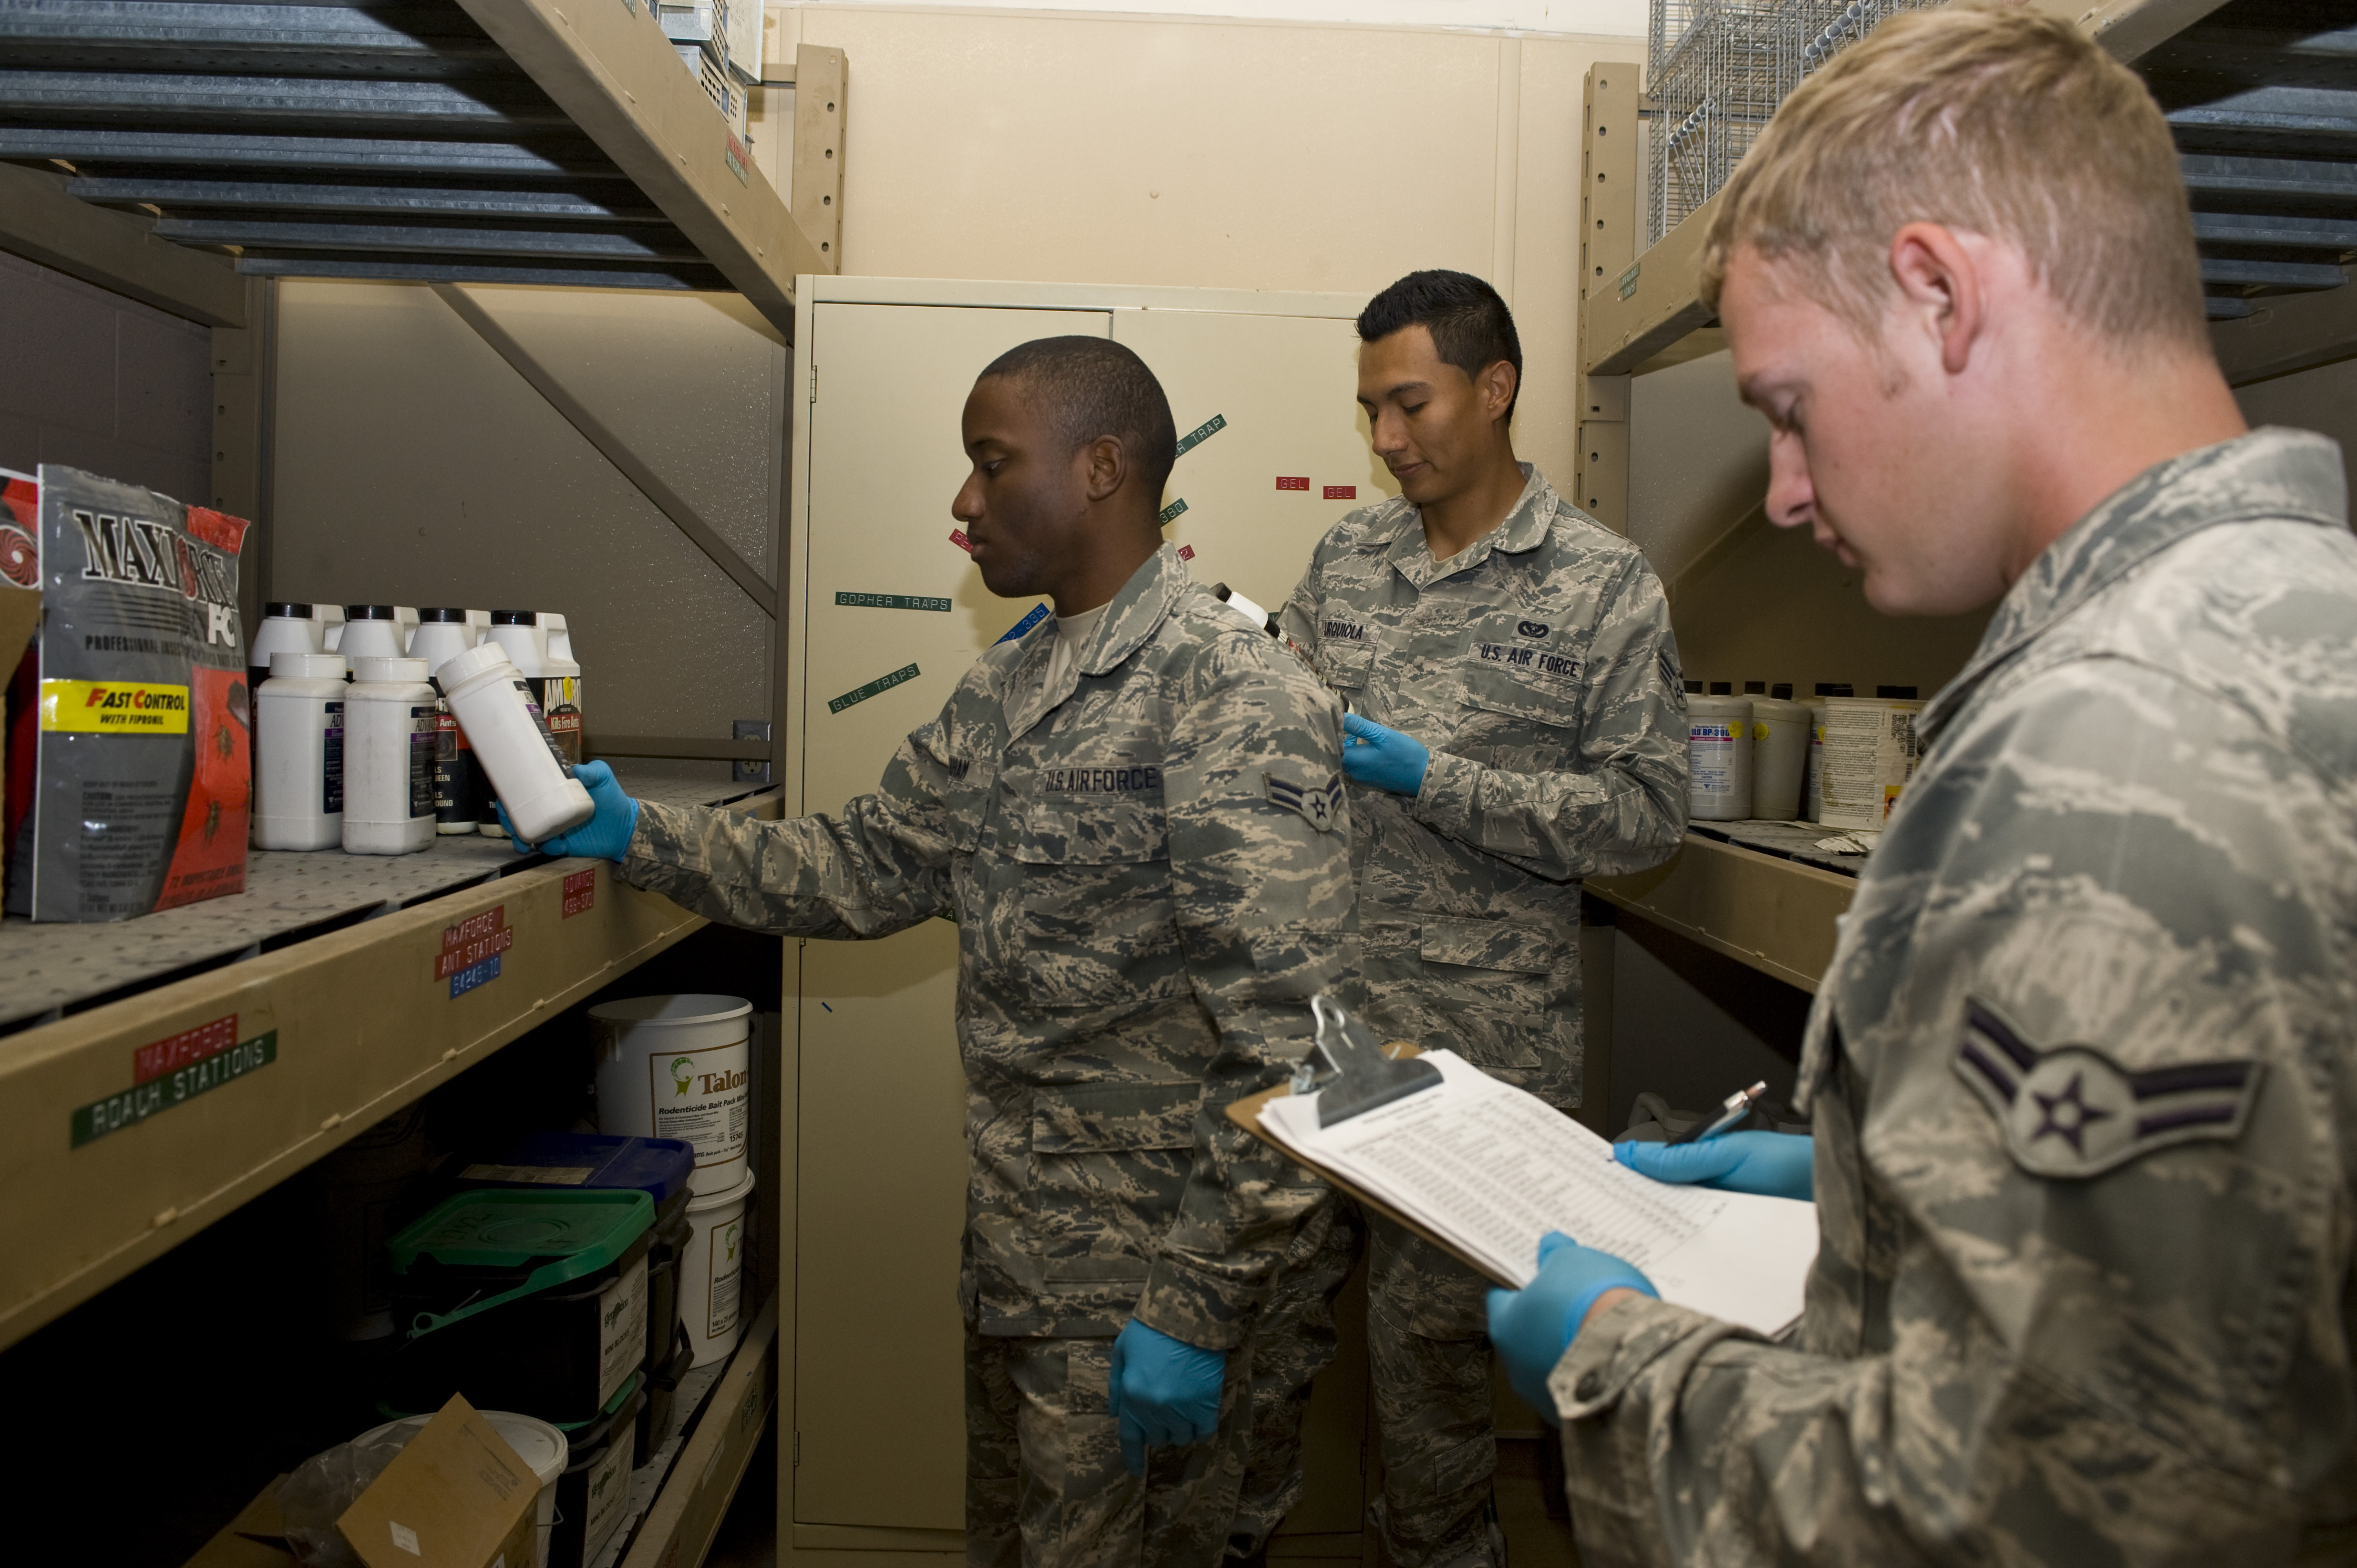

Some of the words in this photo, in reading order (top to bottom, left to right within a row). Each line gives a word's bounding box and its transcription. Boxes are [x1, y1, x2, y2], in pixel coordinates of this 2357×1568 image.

[1175, 443, 1186, 457] R
[1190, 418, 1221, 442] TRAP
[1281, 478, 1304, 489] GEL
[1327, 487, 1351, 498] GEL
[953, 532, 974, 551] PE
[840, 594, 893, 607] GOPHER
[904, 597, 948, 610] TRAPS
[208, 602, 235, 648] FC
[1324, 622, 1363, 639] URQUIOLA
[1480, 643, 1501, 662] U.S.
[1507, 648, 1532, 666] AIR
[1538, 653, 1579, 677] FORCE
[85, 688, 132, 709] FAST
[133, 689, 185, 710] CONTROL
[833, 688, 866, 711] GLUE
[874, 666, 916, 690] TRAPS
[100, 714, 127, 724] WITH
[129, 714, 163, 725] FIPRONIL
[440, 719, 456, 727] Ants
[551, 716, 561, 730] Kills
[562, 716, 570, 729] Fire
[571, 715, 579, 728] Ants
[1045, 770, 1064, 792] U.S.
[1067, 769, 1089, 792] AIR
[1093, 766, 1157, 792] FORCE
[565, 871, 594, 893] ADVANCE
[446, 912, 493, 948] MAXFORCE
[442, 950, 461, 975] ANT
[467, 929, 511, 963] STATIONS
[92, 1081, 162, 1135] ROACH
[174, 1039, 265, 1100] STATIONS
[697, 1069, 747, 1095] Talon
[658, 1104, 707, 1115] Rodenticide
[708, 1101, 723, 1110] Bait
[723, 1098, 736, 1106] Pack
[614, 1328, 629, 1348] BLOCKS
